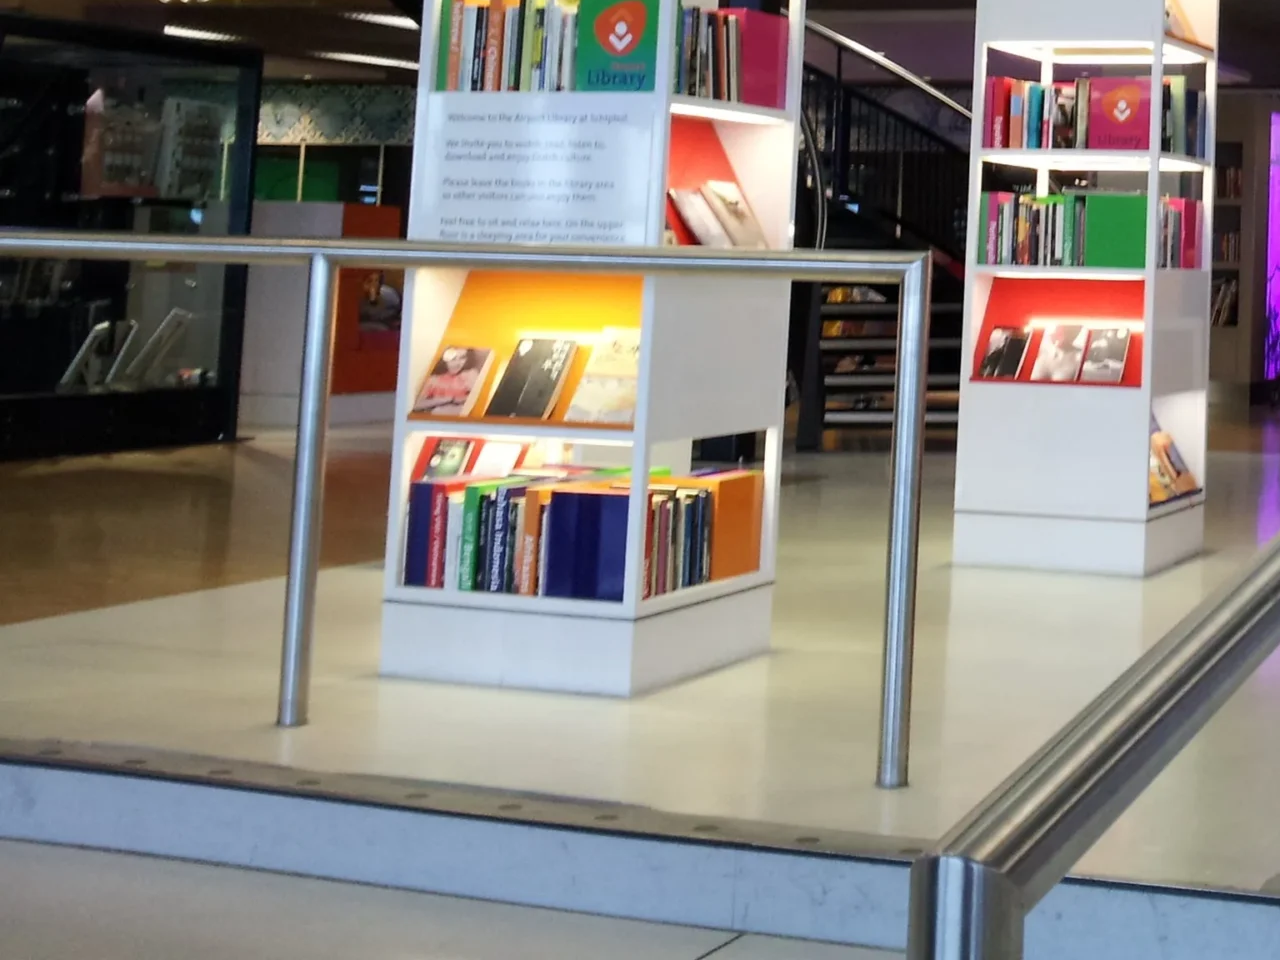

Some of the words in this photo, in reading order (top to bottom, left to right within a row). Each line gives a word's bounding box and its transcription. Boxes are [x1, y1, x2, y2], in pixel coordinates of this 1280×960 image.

[587, 68, 646, 91] Library
[499, 112, 512, 123] the
[489, 531, 504, 592] Indonesia
[521, 534, 534, 593] Afrikaans
